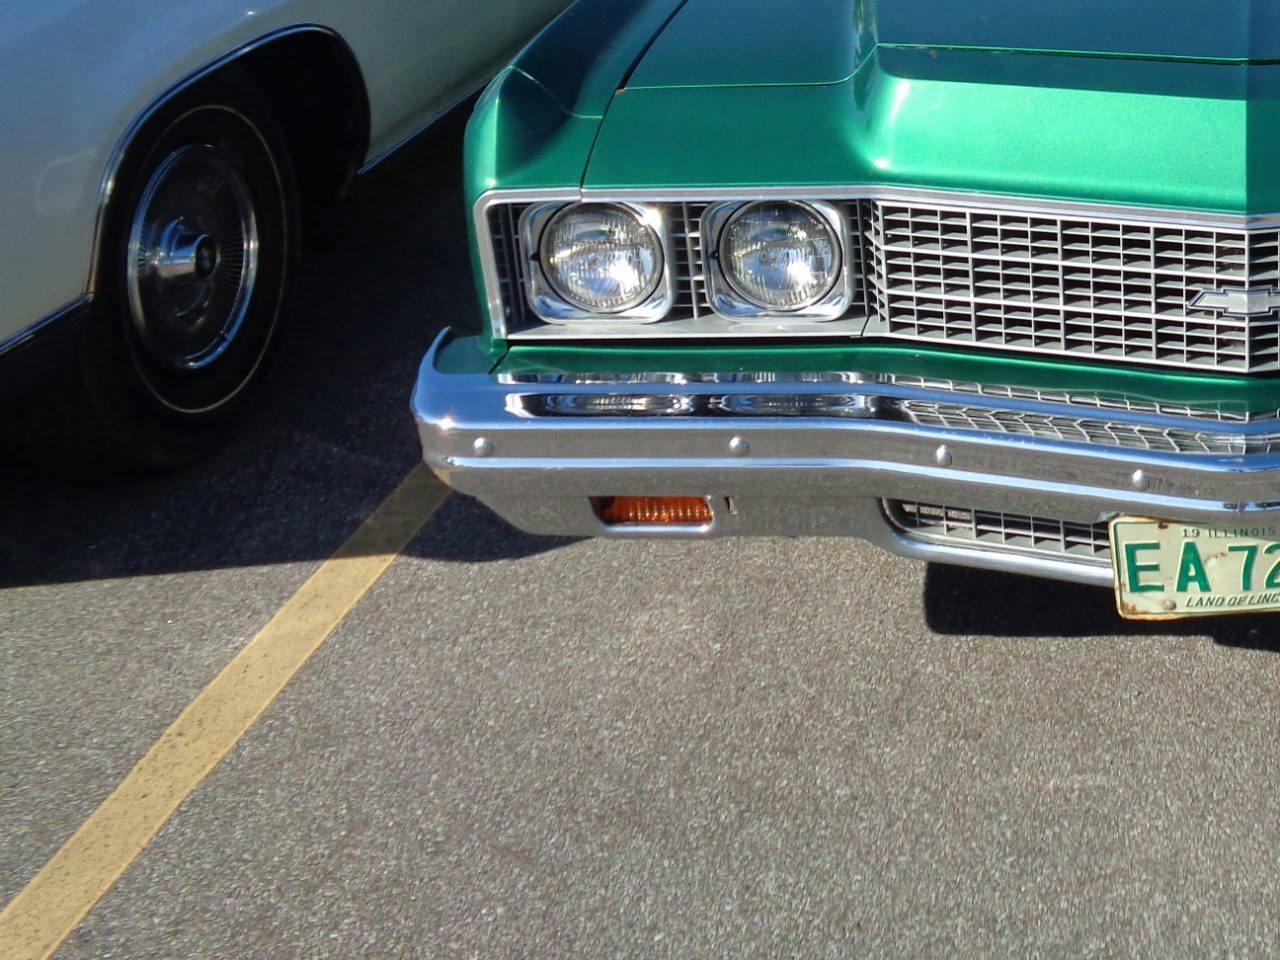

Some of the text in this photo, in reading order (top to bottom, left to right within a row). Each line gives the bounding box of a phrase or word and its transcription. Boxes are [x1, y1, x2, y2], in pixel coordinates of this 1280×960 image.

[1183, 528, 1200, 538] 19
[1208, 526, 1276, 539] ILLINOIS
[1124, 541, 1212, 593] EA
[1186, 596, 1226, 608] LAND
[1227, 595, 1248, 607] OF
